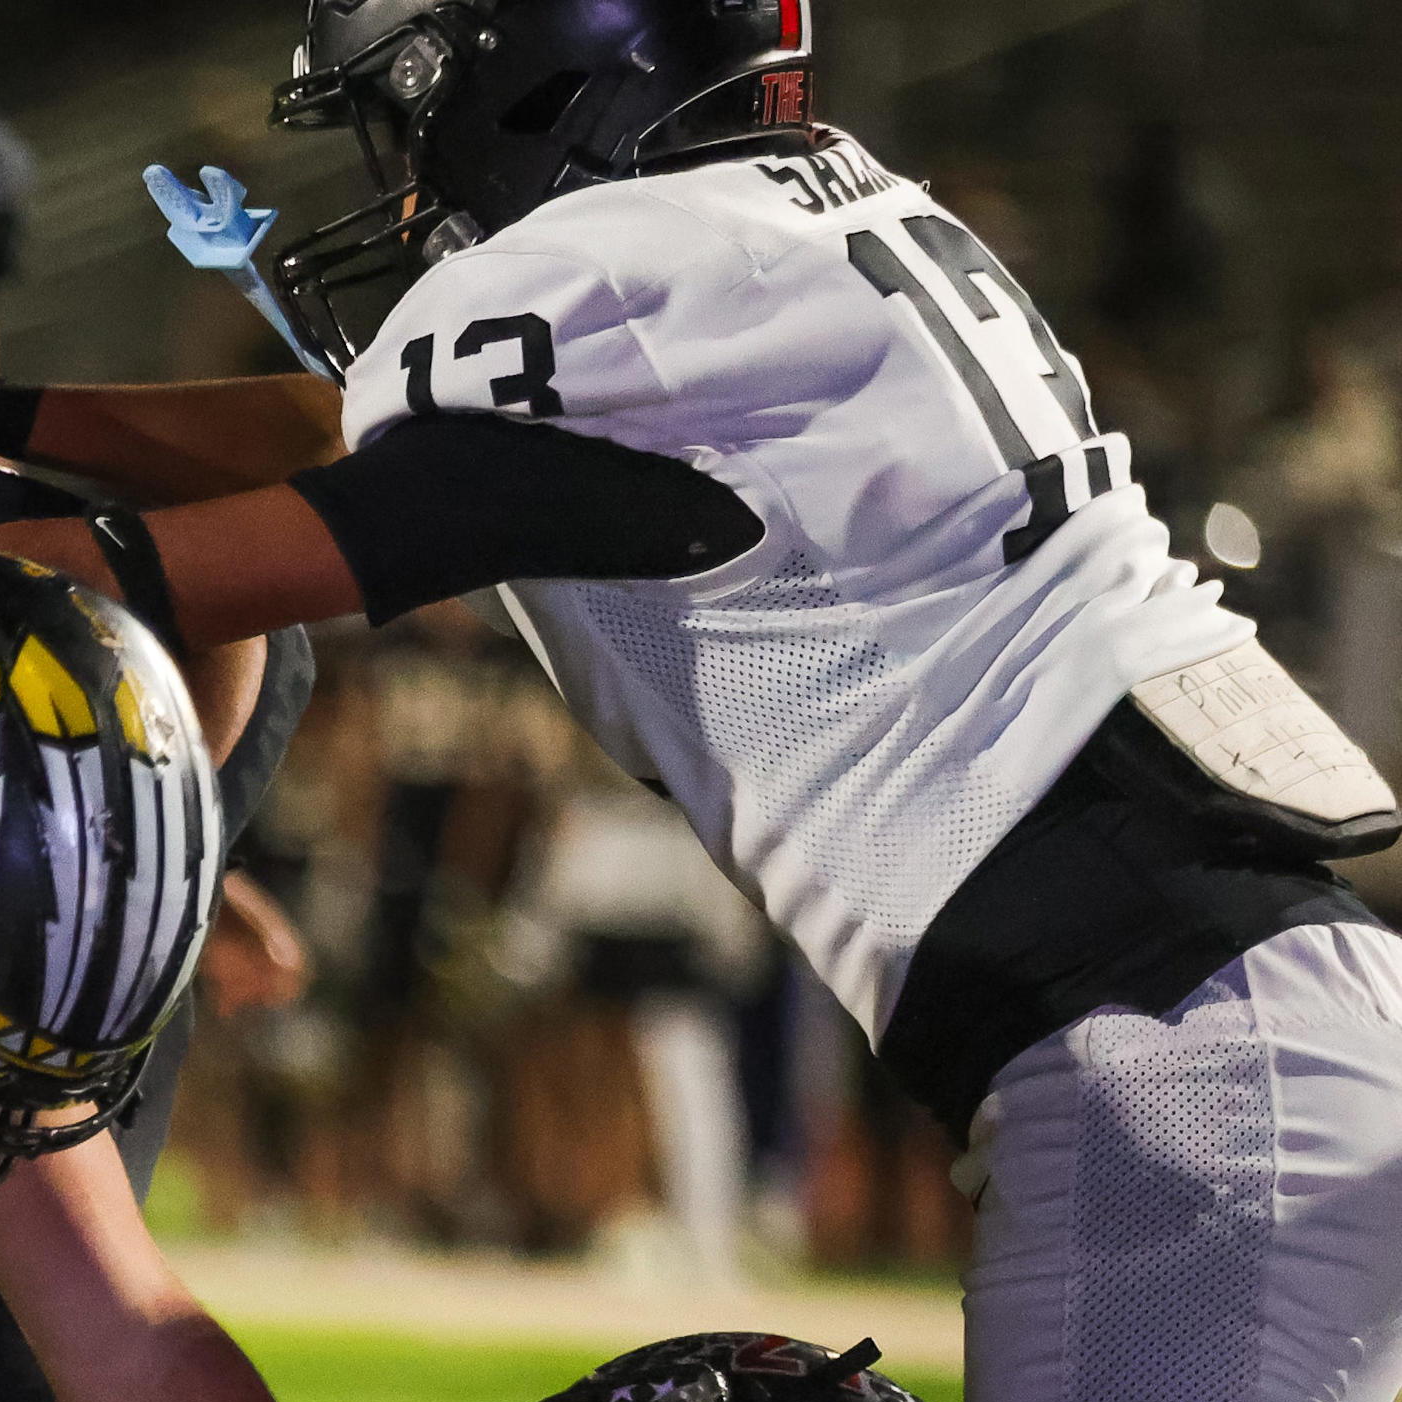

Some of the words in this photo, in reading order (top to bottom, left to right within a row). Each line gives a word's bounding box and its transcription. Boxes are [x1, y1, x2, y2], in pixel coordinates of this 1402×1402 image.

[762, 71, 804, 126] THE
[400, 312, 566, 418] 13
[846, 214, 1114, 566] 13
